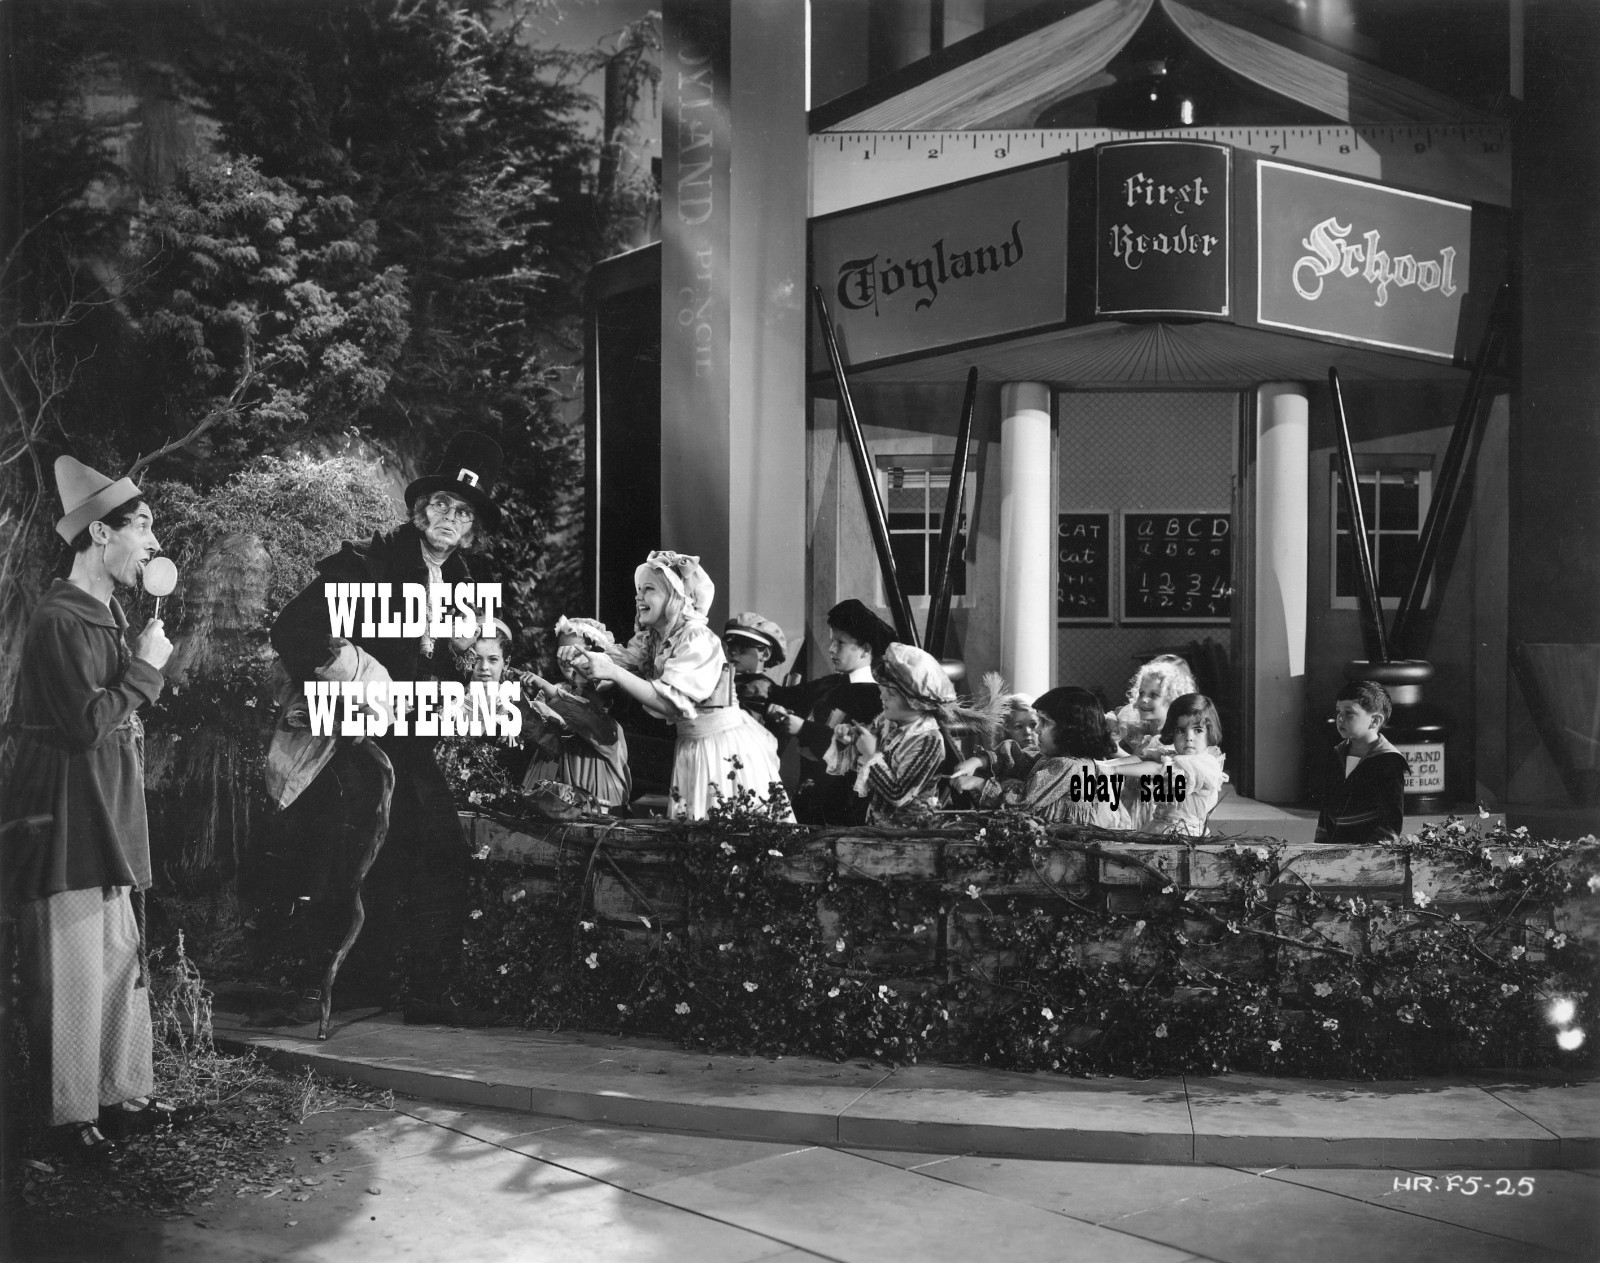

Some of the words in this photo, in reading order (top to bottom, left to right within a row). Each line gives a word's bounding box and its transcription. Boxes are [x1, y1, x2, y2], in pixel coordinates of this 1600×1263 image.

[863, 150, 870, 160] 1
[928, 149, 938, 159] 2
[995, 148, 1006, 159] 3
[1270, 145, 1280, 155] 7
[1339, 145, 1350, 155] 8
[1122, 172, 1210, 214] First
[1109, 223, 1219, 270] Reader
[1292, 216, 1457, 308] School
[837, 220, 1024, 318] Toyland
[1057, 523, 1101, 539] CAT
[1165, 517, 1180, 536] B
[1187, 517, 1202, 537] C
[1212, 518, 1229, 537] D
